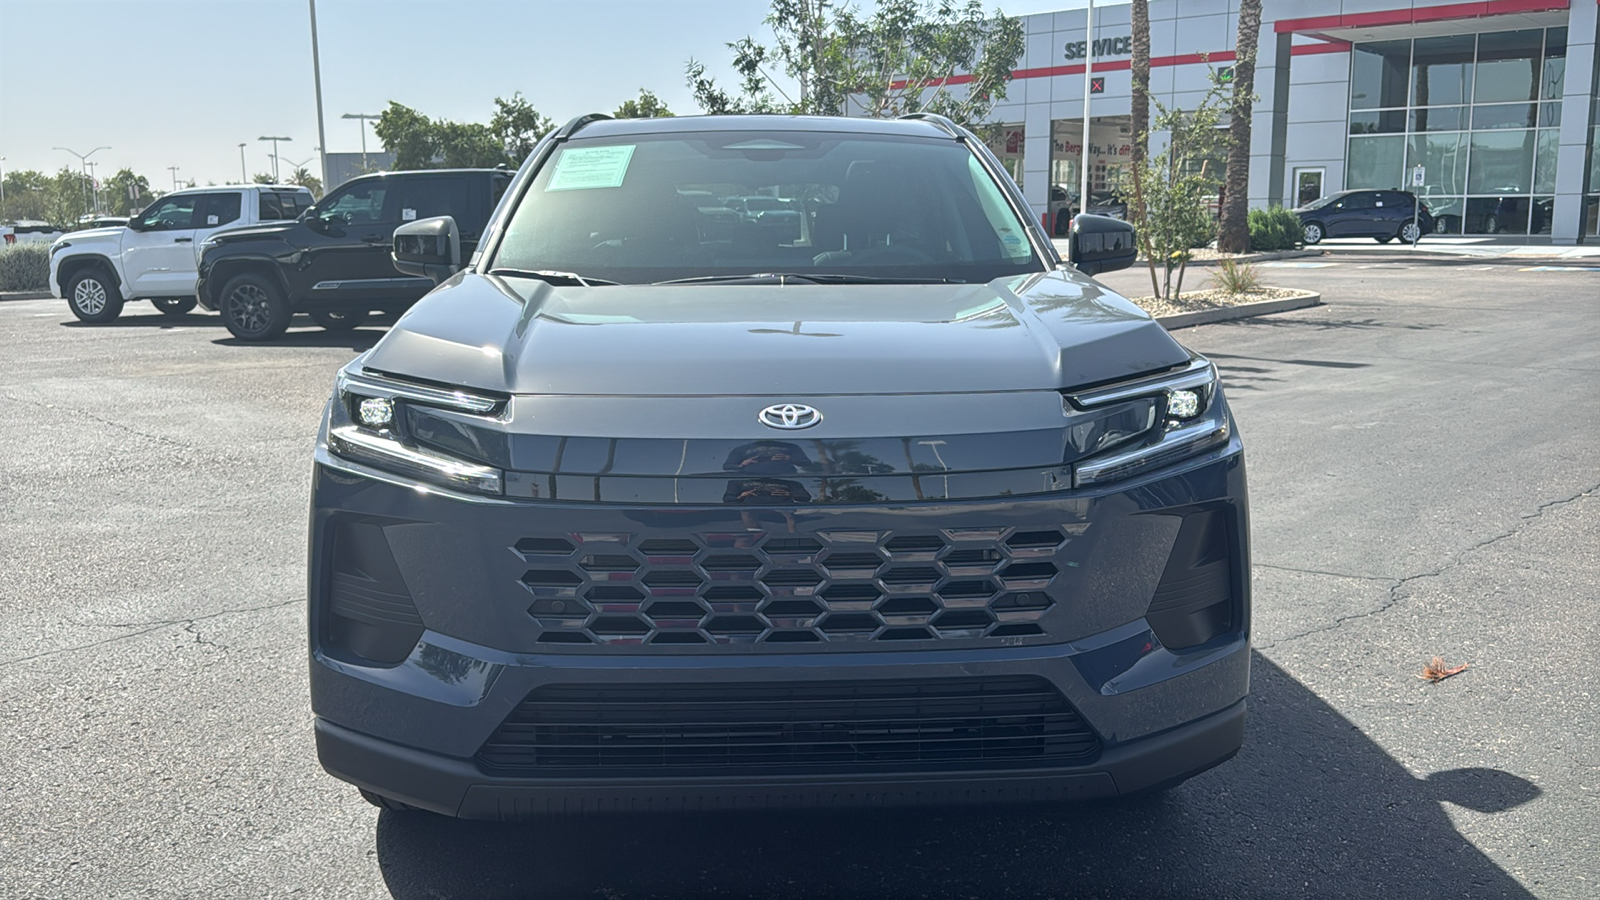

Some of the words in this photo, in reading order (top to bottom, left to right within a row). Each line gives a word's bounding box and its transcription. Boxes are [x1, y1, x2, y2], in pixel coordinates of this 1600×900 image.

[1064, 36, 1132, 60] SERVICE
[1065, 141, 1083, 156] Berg
[1107, 143, 1117, 155] it's
